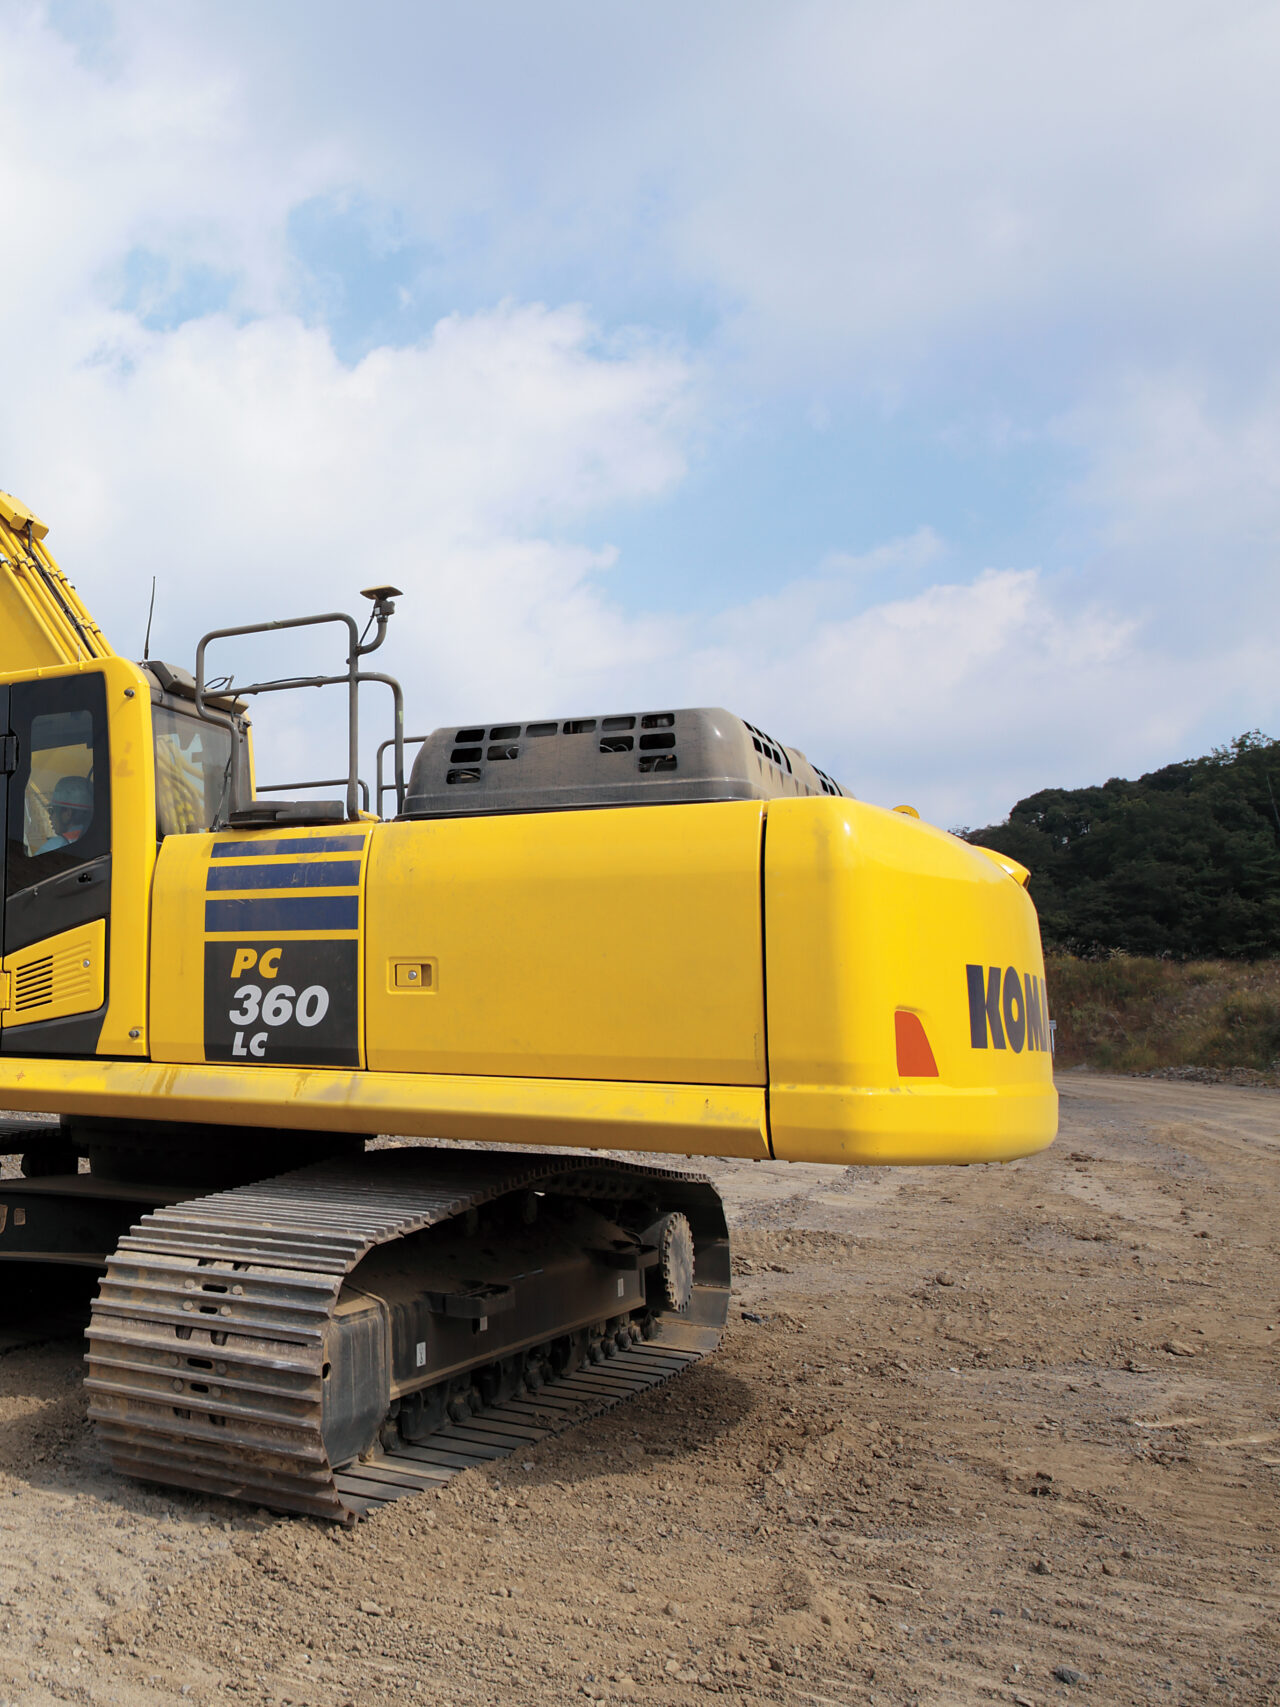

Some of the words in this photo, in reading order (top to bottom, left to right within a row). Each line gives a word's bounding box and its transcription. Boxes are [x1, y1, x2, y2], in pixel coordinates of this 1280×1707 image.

[230, 948, 282, 978] PC
[229, 984, 330, 1027] 360
[231, 1031, 268, 1057] LC
